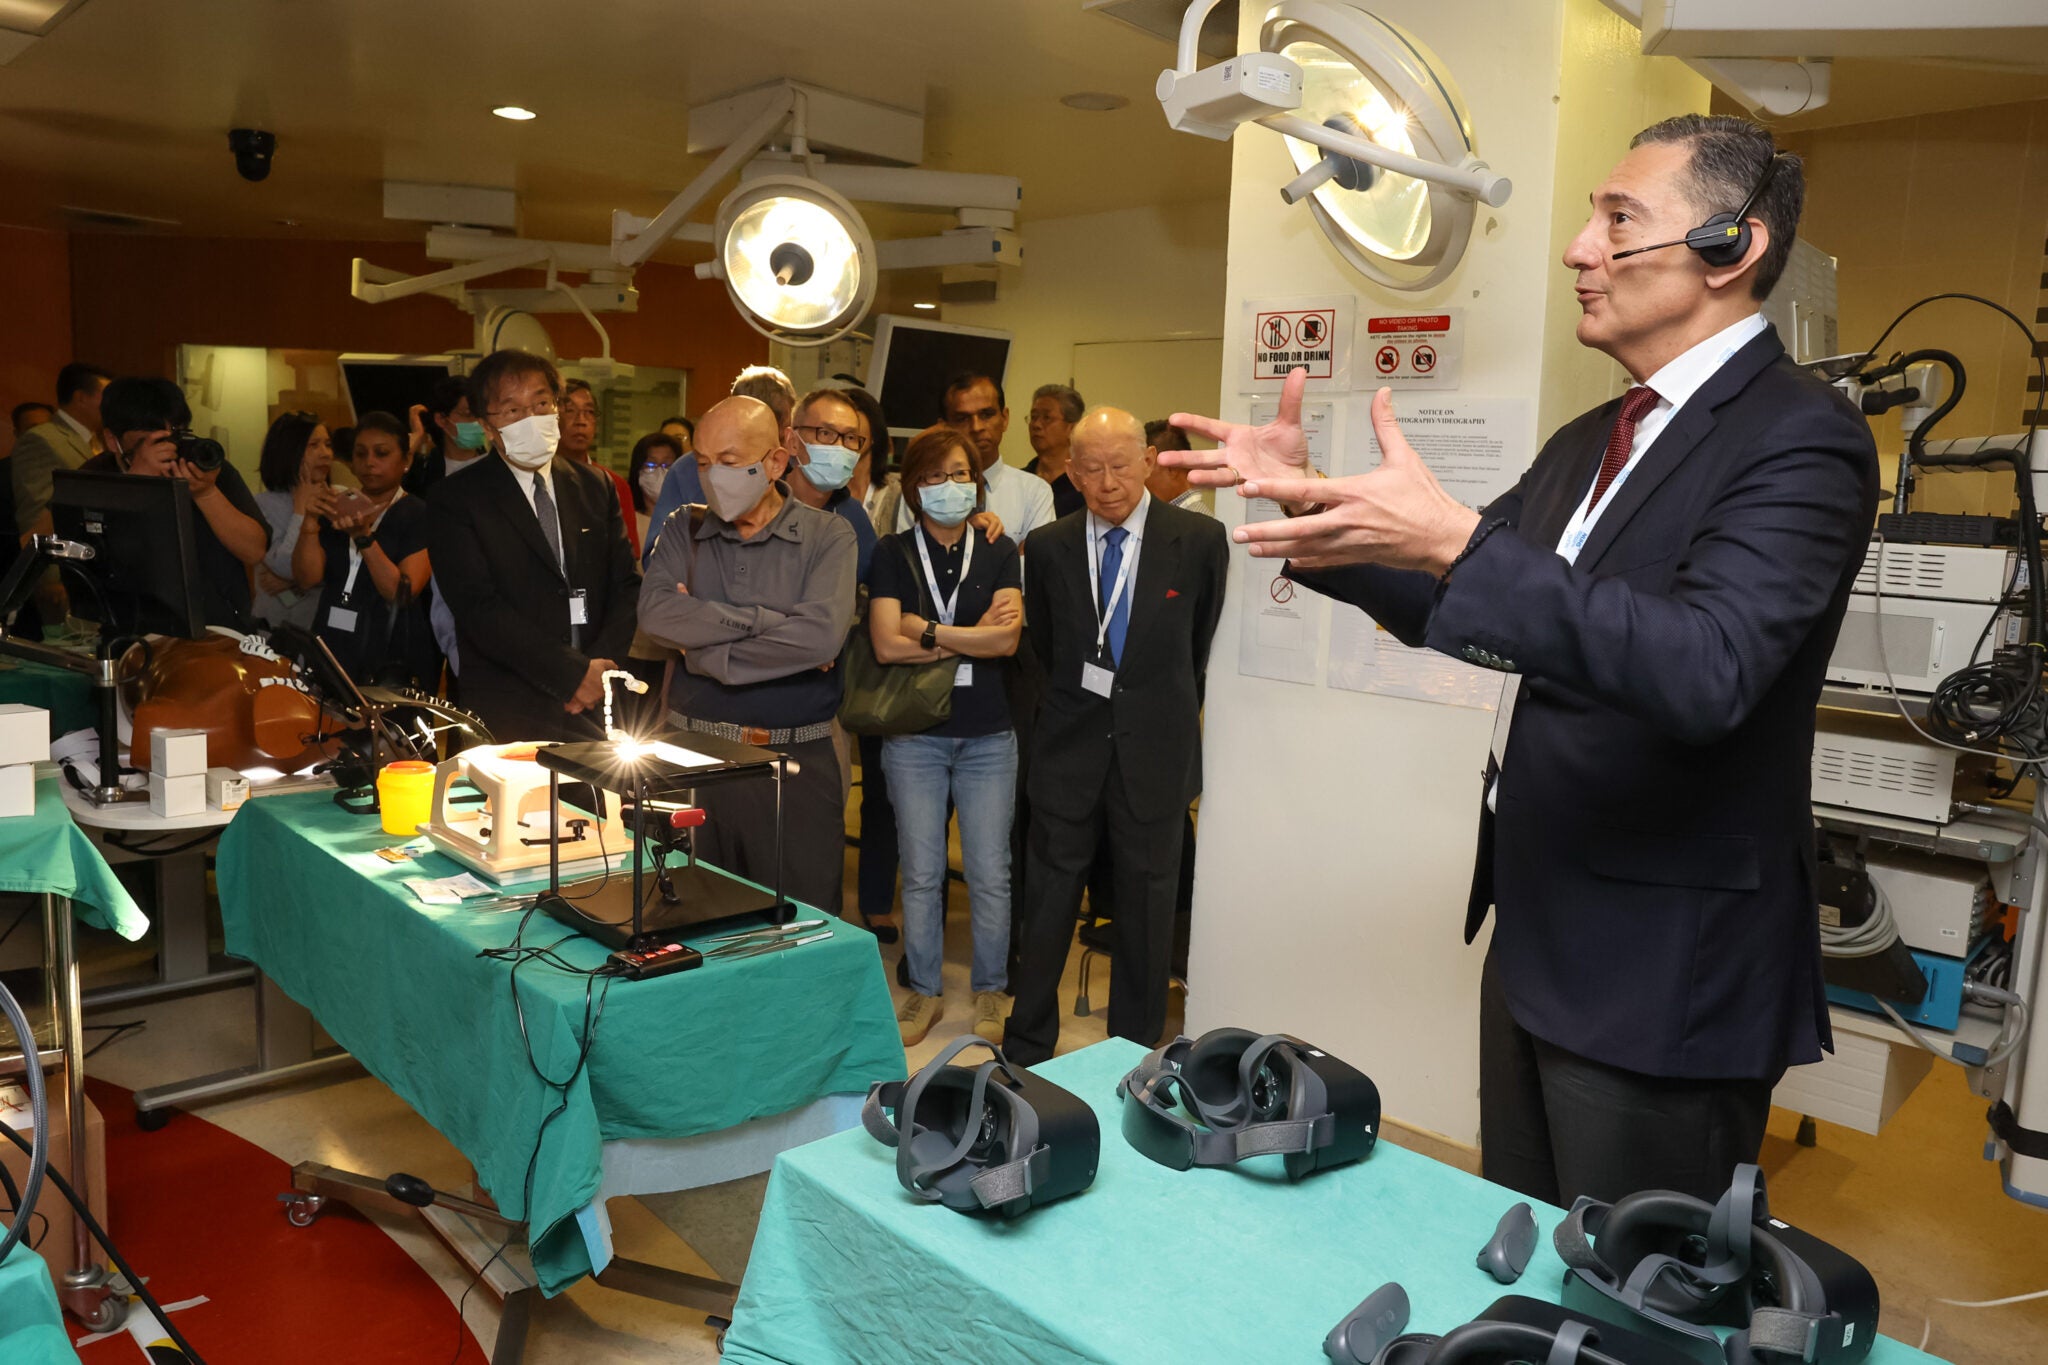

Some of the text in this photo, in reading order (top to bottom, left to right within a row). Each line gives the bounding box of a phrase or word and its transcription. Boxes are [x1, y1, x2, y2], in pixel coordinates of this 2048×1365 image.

[1257, 350, 1330, 362] NO FOOD OR DRINK
[1273, 363, 1310, 374] ALLOD
[1395, 417, 1486, 425] OTOGRAPHY/VIDEOGRAPHY
